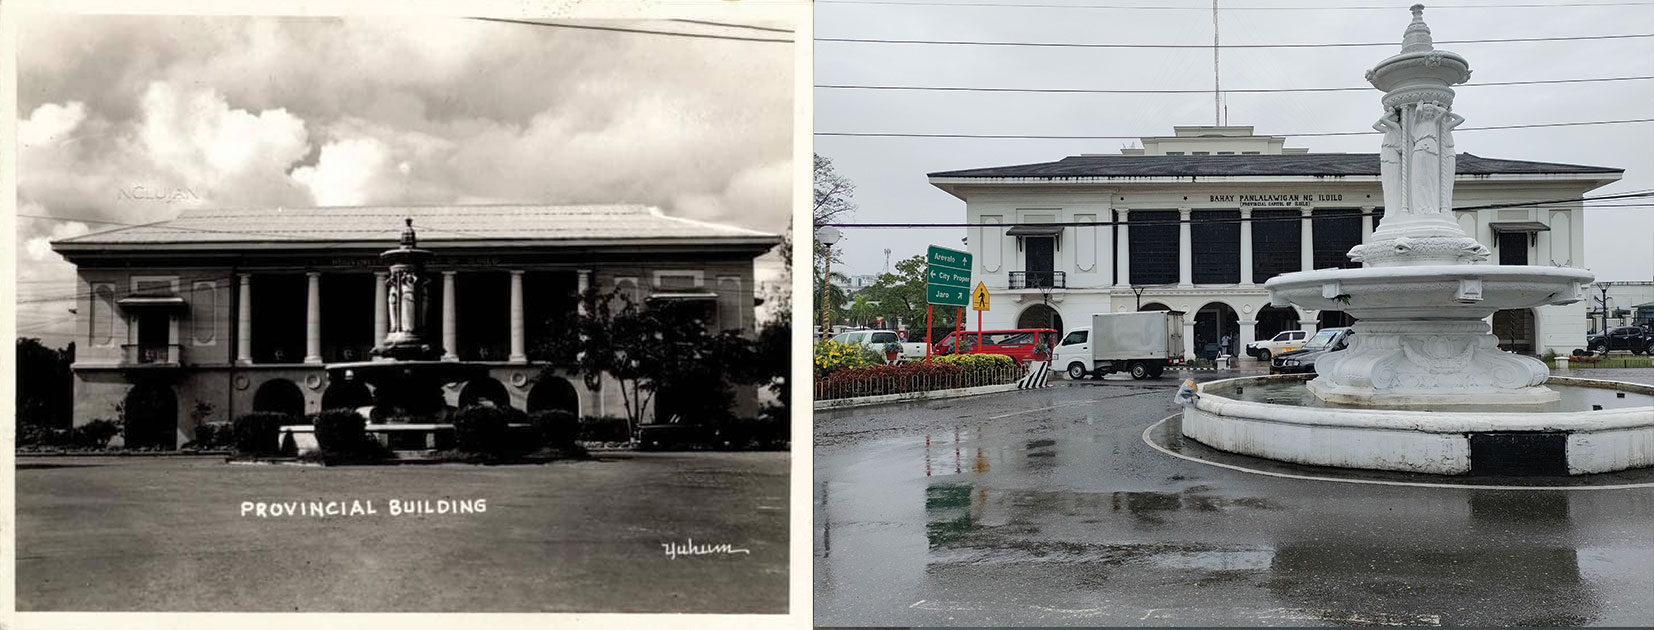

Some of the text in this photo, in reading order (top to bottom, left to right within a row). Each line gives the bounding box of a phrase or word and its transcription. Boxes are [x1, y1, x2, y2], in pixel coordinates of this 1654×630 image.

[1239, 194, 1299, 202] PANLALAWIGAN
[934, 253, 955, 262] Arevalo
[939, 272, 970, 283] City Proper
